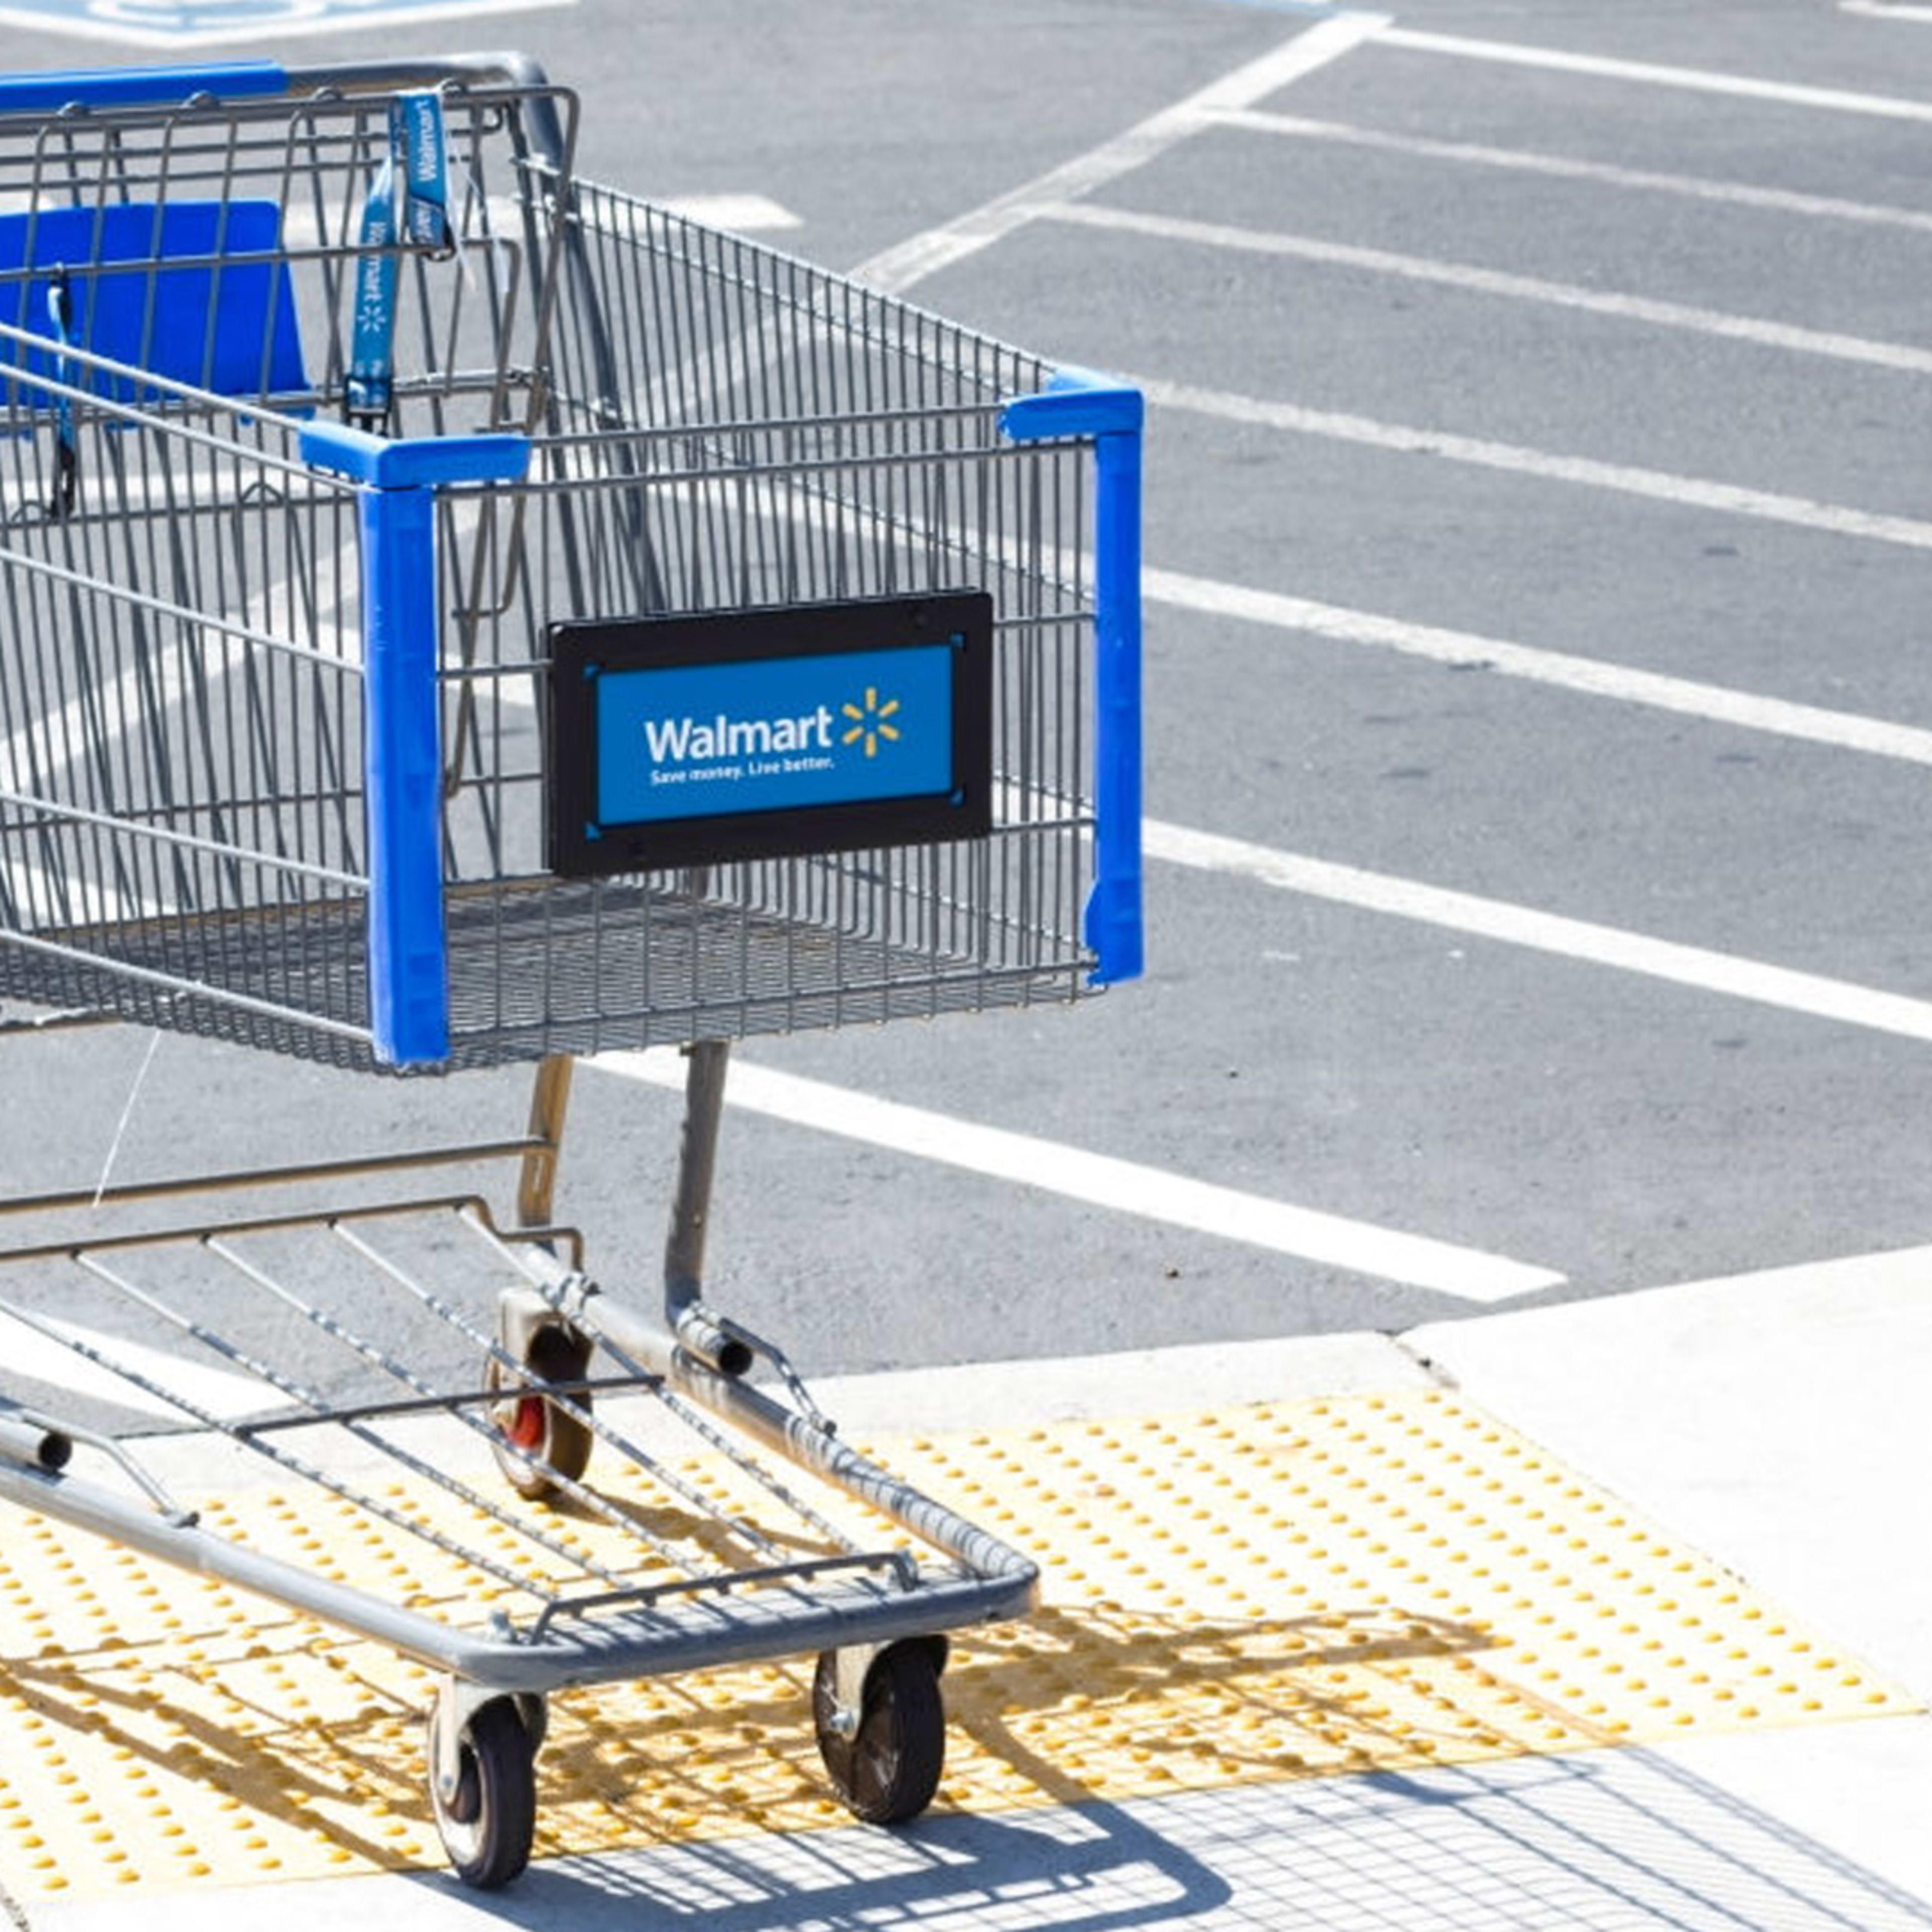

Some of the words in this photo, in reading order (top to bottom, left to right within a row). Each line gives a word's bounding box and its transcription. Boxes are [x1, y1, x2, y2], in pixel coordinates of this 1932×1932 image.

[415, 99, 437, 182] Walmart
[363, 221, 387, 302] Wamart
[645, 705, 833, 763] Walmart
[652, 769, 686, 785] Save
[690, 766, 744, 781] money.
[749, 761, 780, 775] Live
[783, 756, 836, 772] better.
